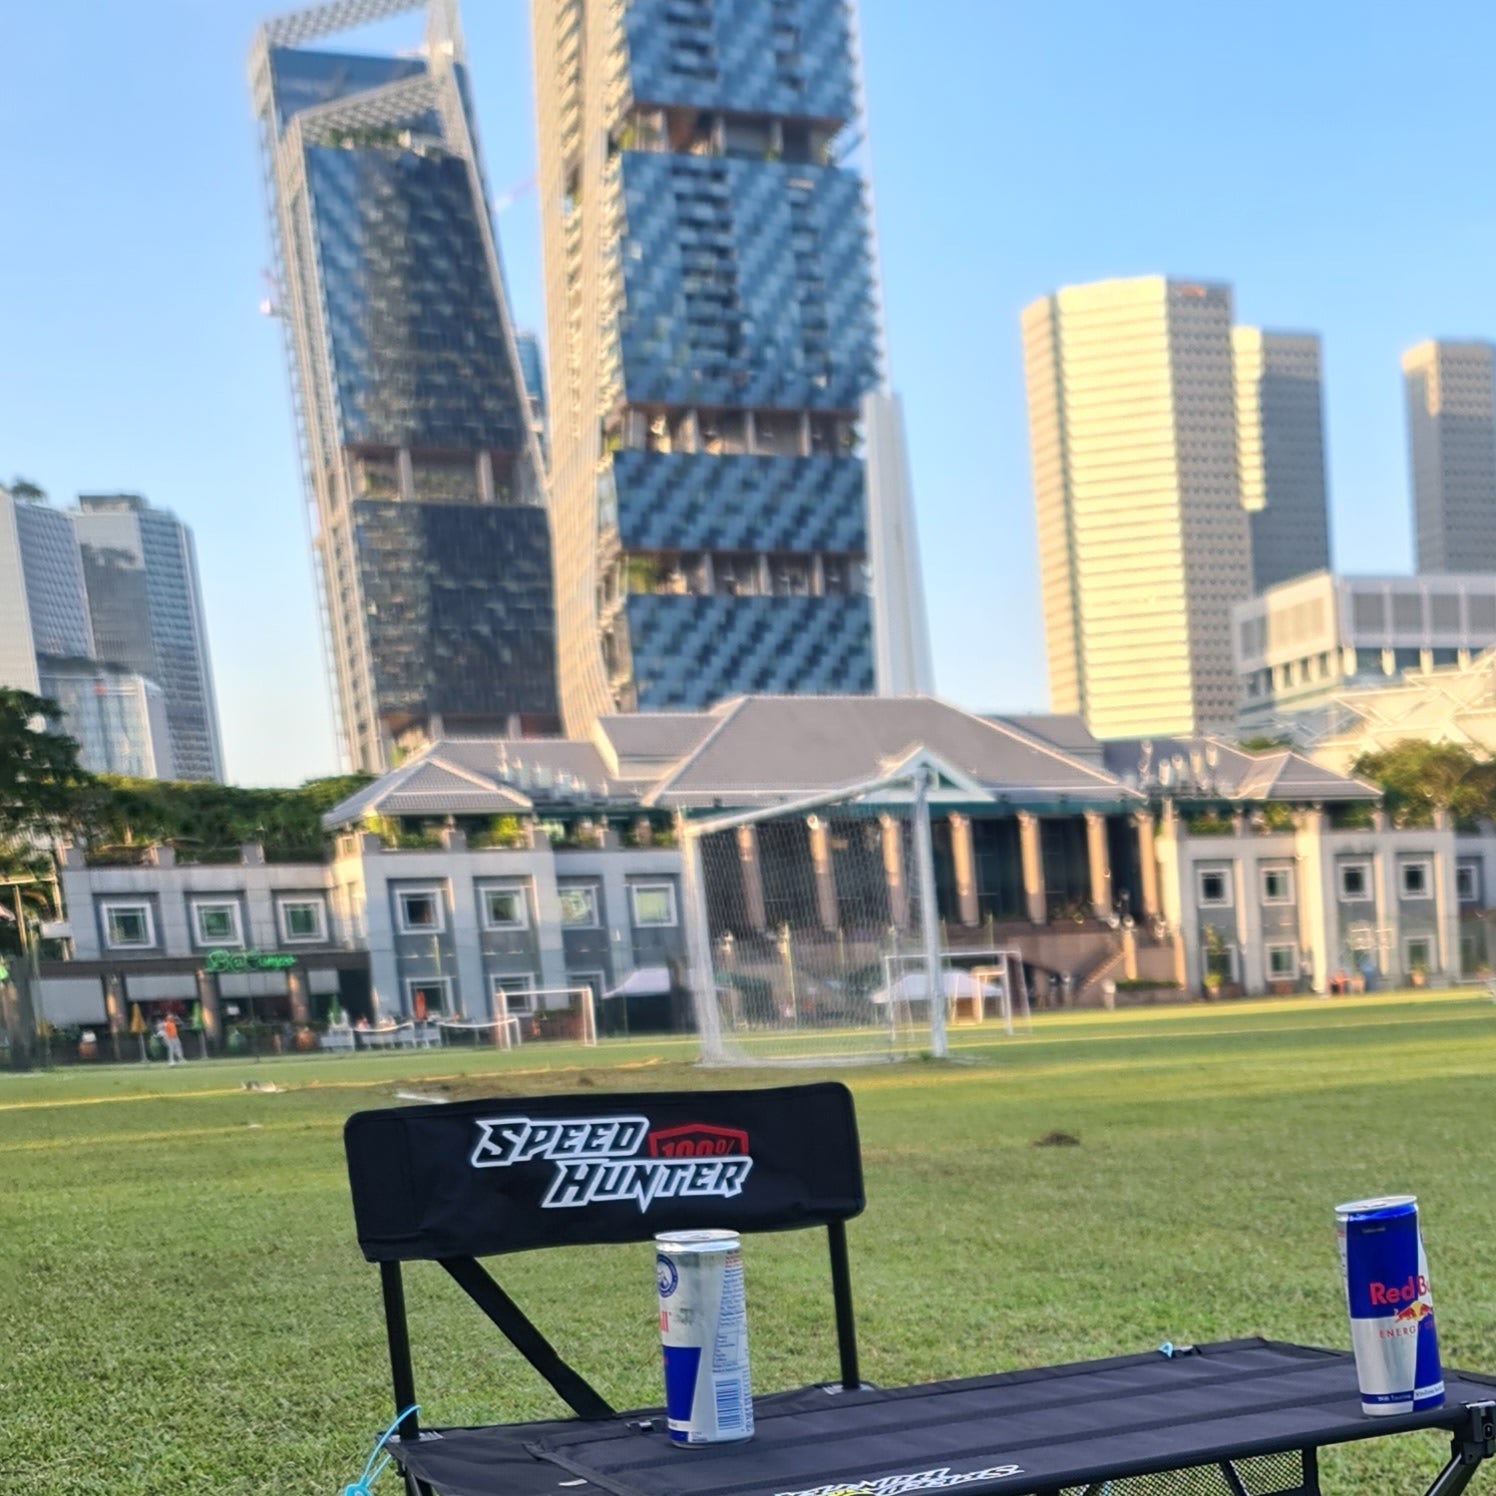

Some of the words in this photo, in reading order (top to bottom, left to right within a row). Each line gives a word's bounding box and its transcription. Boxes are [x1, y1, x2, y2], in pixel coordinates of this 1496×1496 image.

[470, 1115, 649, 1168] SPEED
[541, 1156, 753, 1213] HUNTER
[1369, 1276, 1415, 1306] Red
